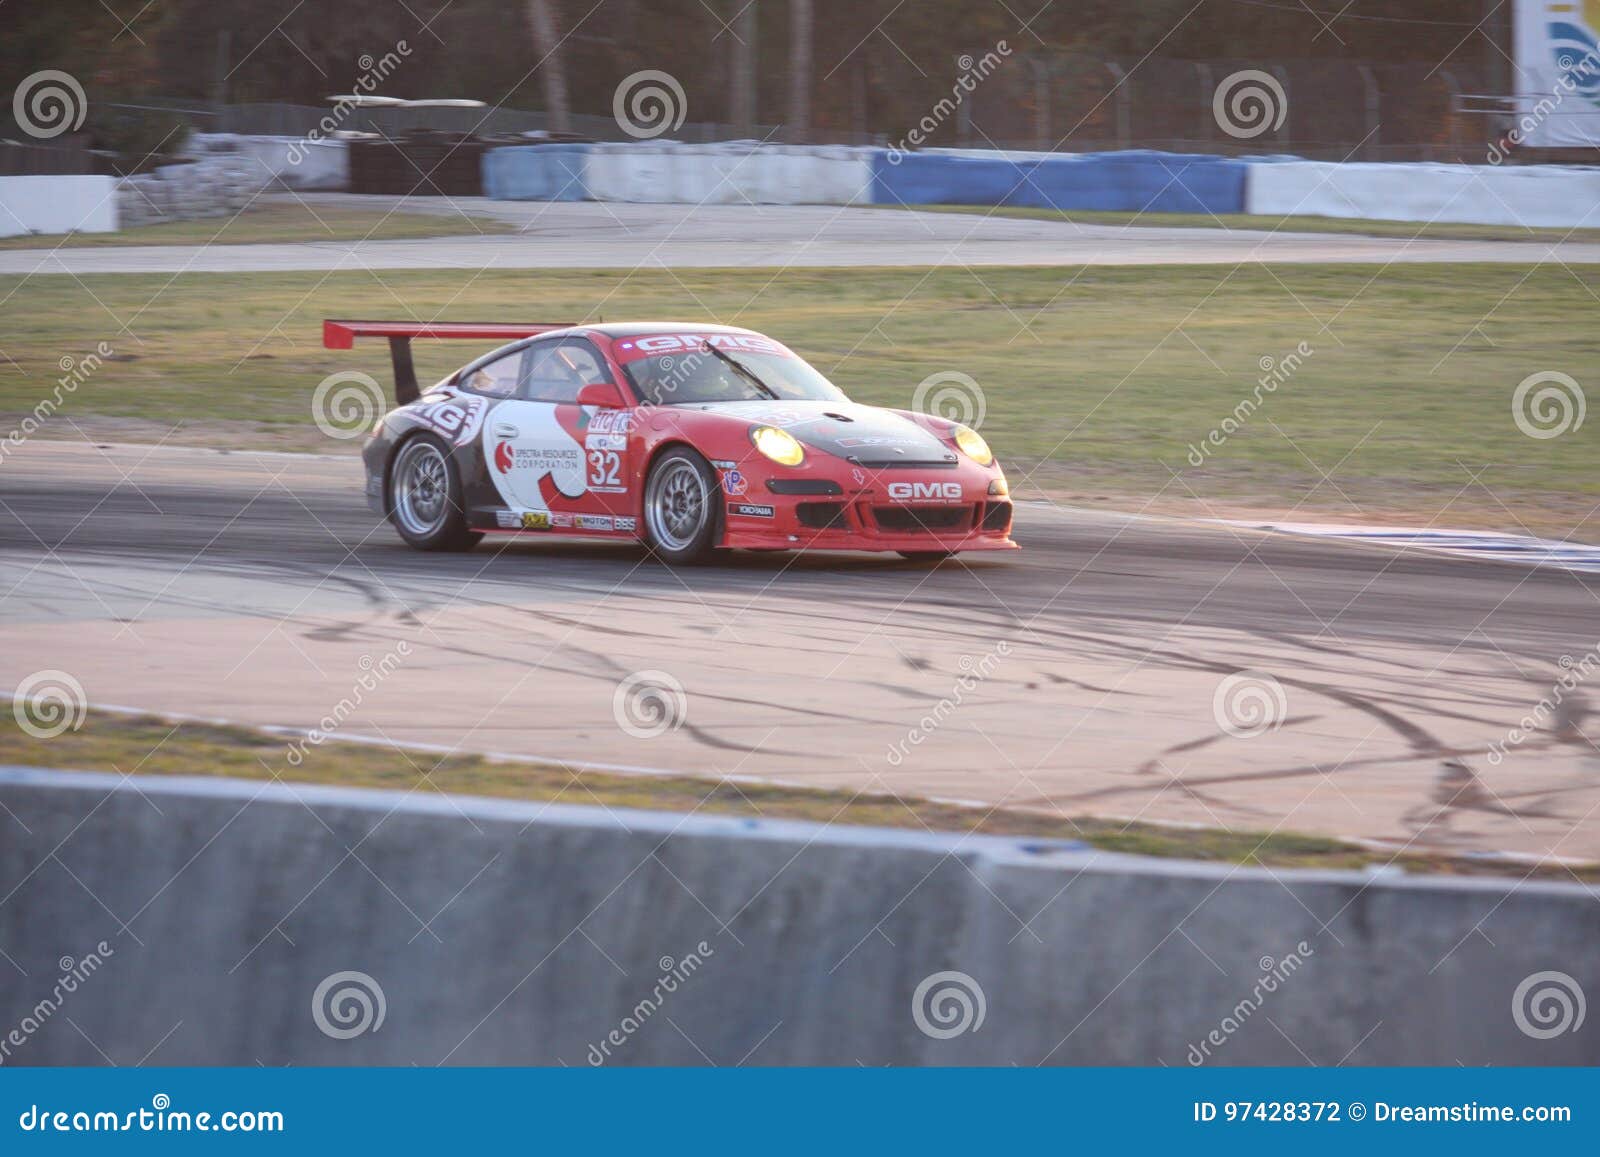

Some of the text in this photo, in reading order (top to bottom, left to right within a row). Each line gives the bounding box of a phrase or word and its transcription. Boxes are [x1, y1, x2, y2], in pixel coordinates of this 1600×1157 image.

[635, 334, 778, 351] GMG
[515, 449, 577, 459] SPECTRA RESOURCES
[515, 460, 578, 470] CORPORATION
[589, 450, 620, 485] 32
[888, 482, 962, 498] GMG
